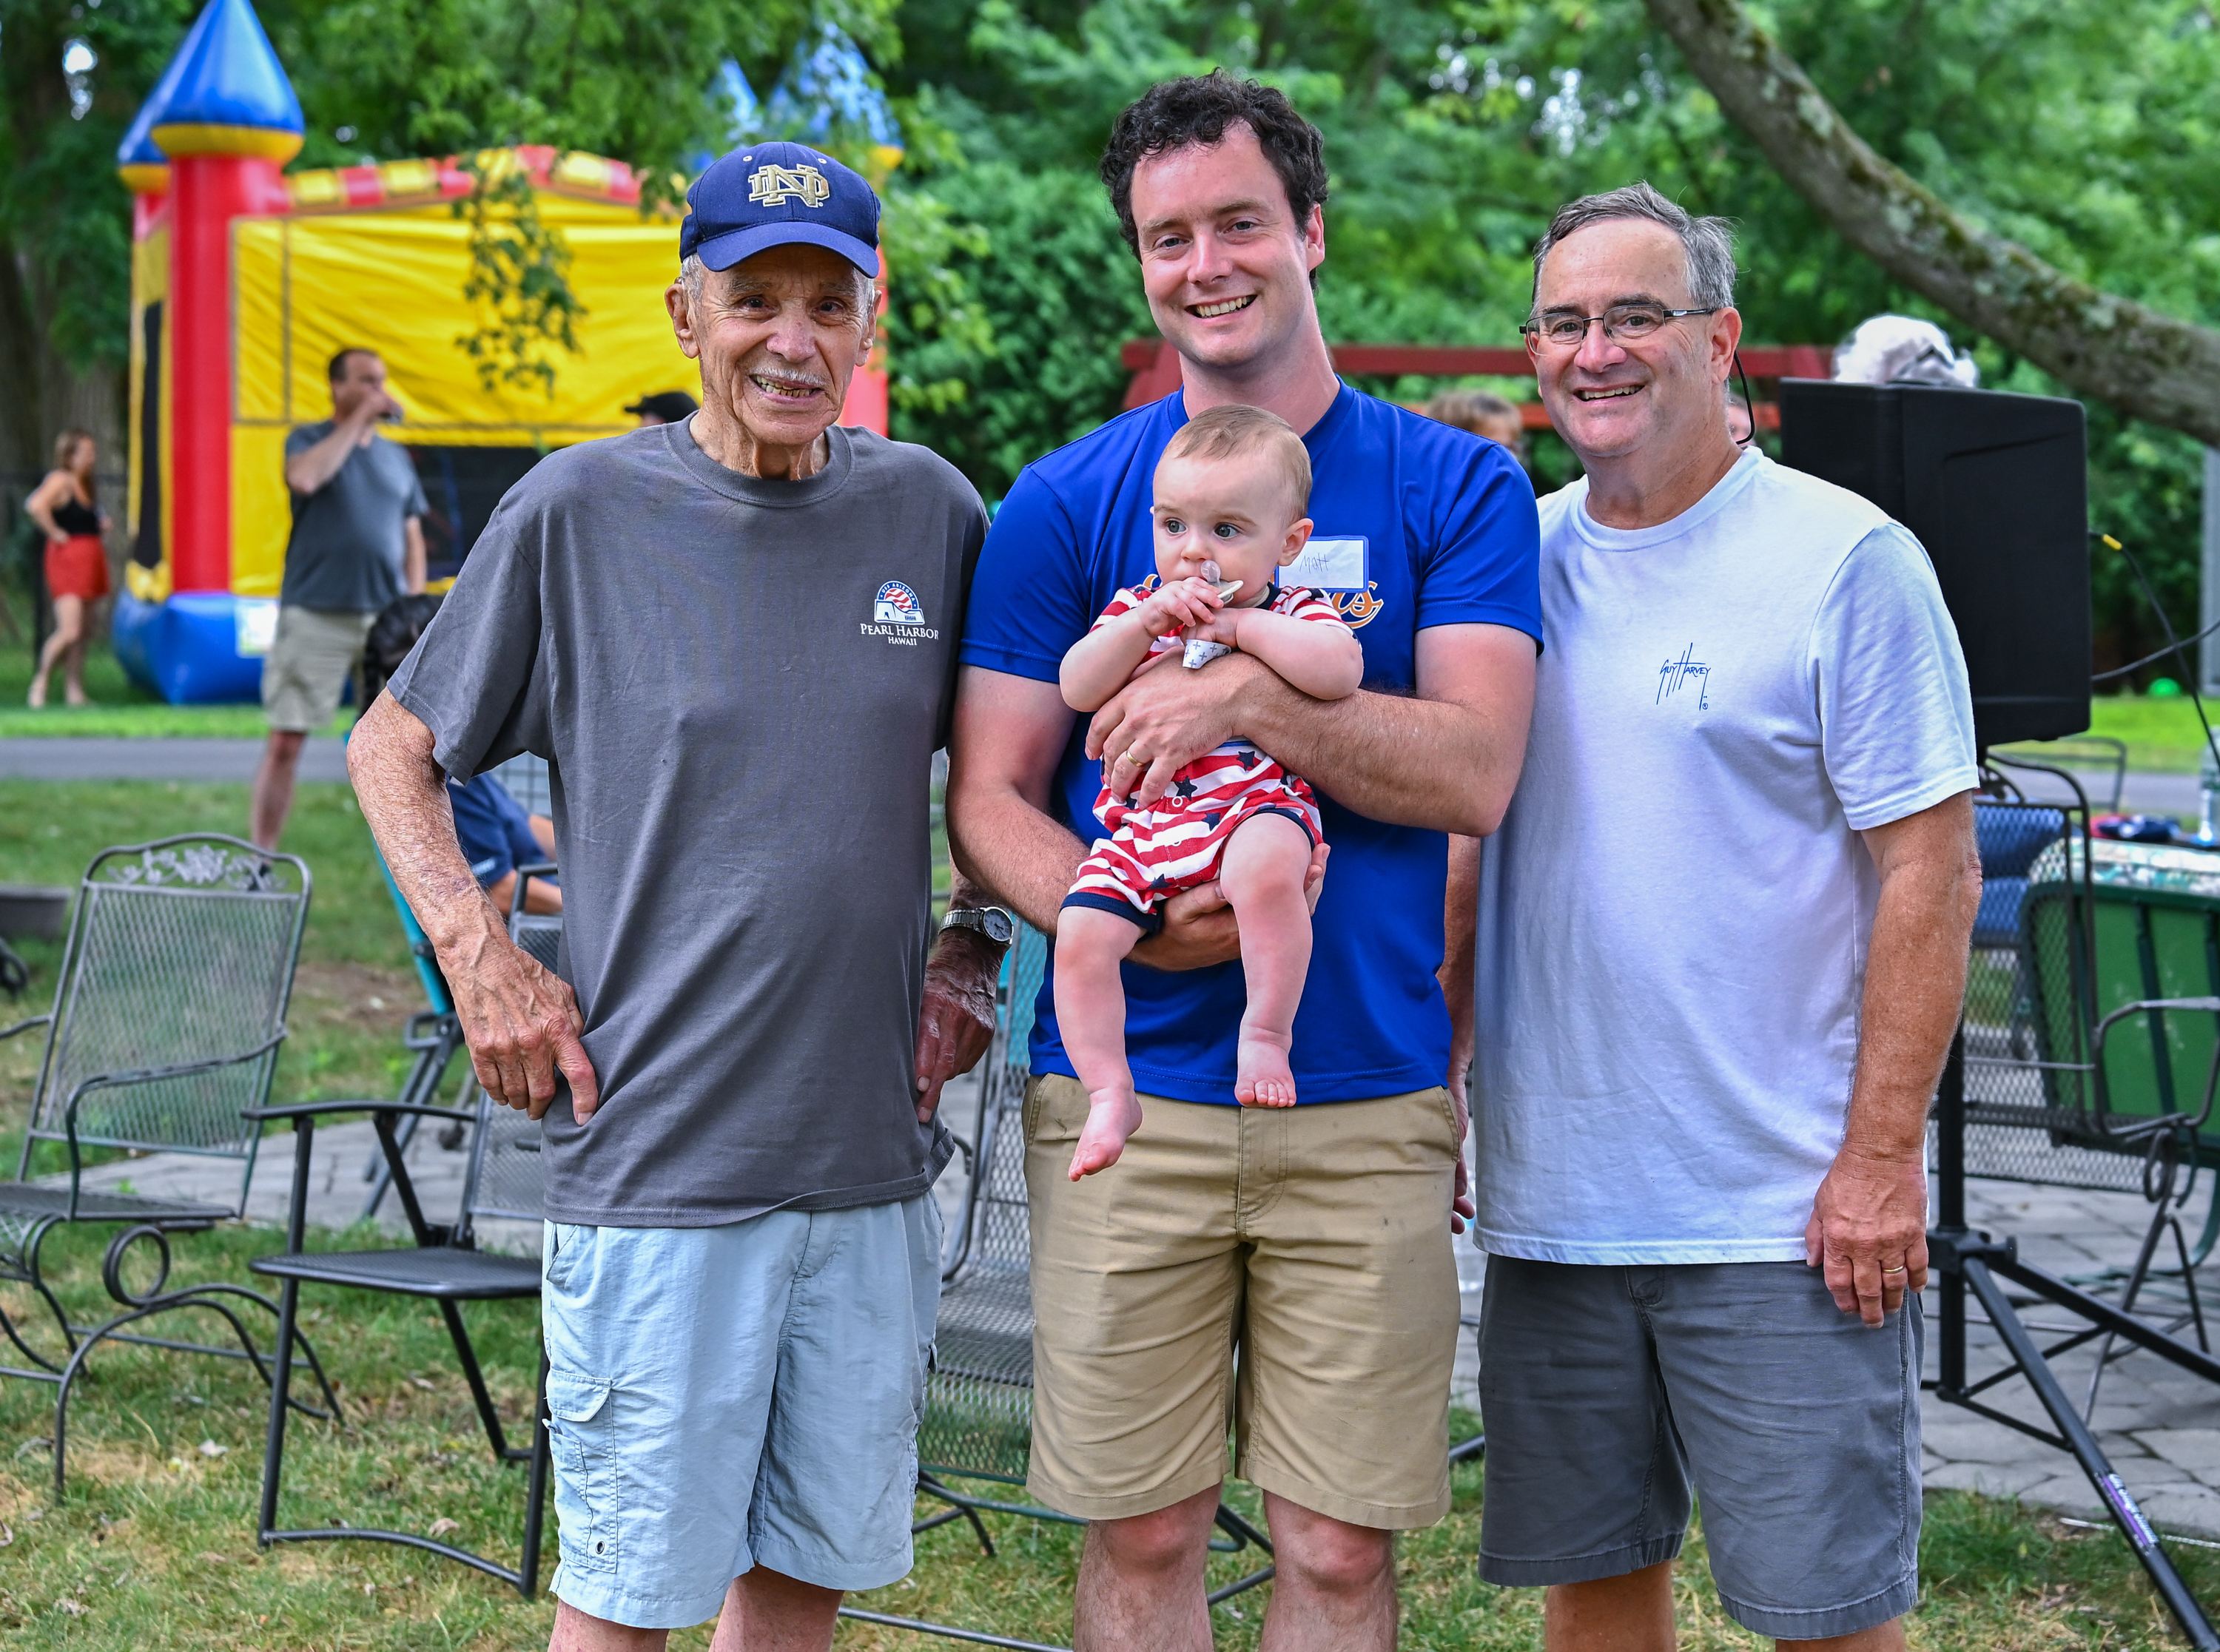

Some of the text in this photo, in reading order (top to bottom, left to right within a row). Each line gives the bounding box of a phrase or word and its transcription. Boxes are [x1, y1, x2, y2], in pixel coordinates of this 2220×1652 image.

[860, 623, 939, 640] PEARL HARBOR
[888, 636, 918, 646] HAWAII
